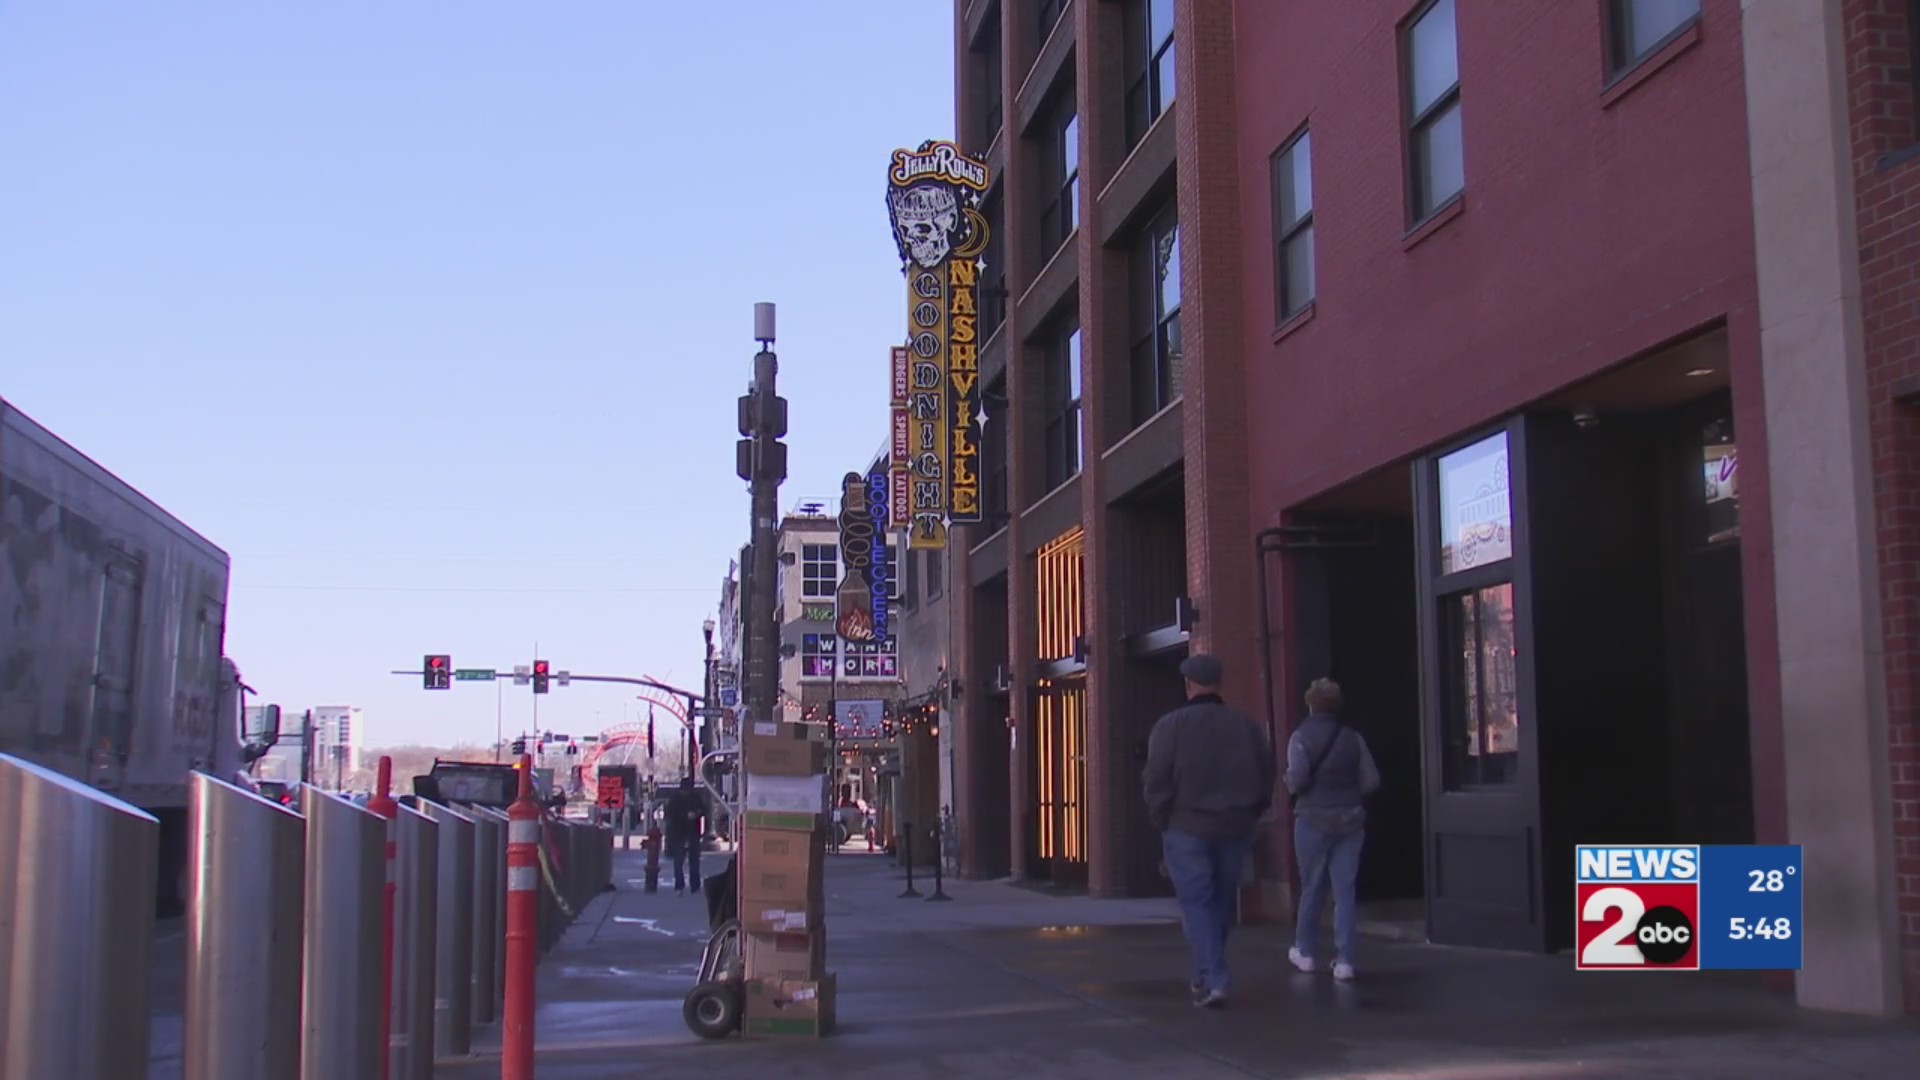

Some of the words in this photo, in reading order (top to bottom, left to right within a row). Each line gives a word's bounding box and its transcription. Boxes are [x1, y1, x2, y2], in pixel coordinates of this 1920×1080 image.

[895, 350, 907, 398] BURGERS
[950, 259, 978, 514] NASHVILLE
[912, 272, 941, 539] GOODNIGHT
[895, 415, 907, 458] SPIRITS
[895, 474, 907, 520] TATTOOS
[820, 640, 893, 652] WANT
[821, 659, 893, 671] MORE
